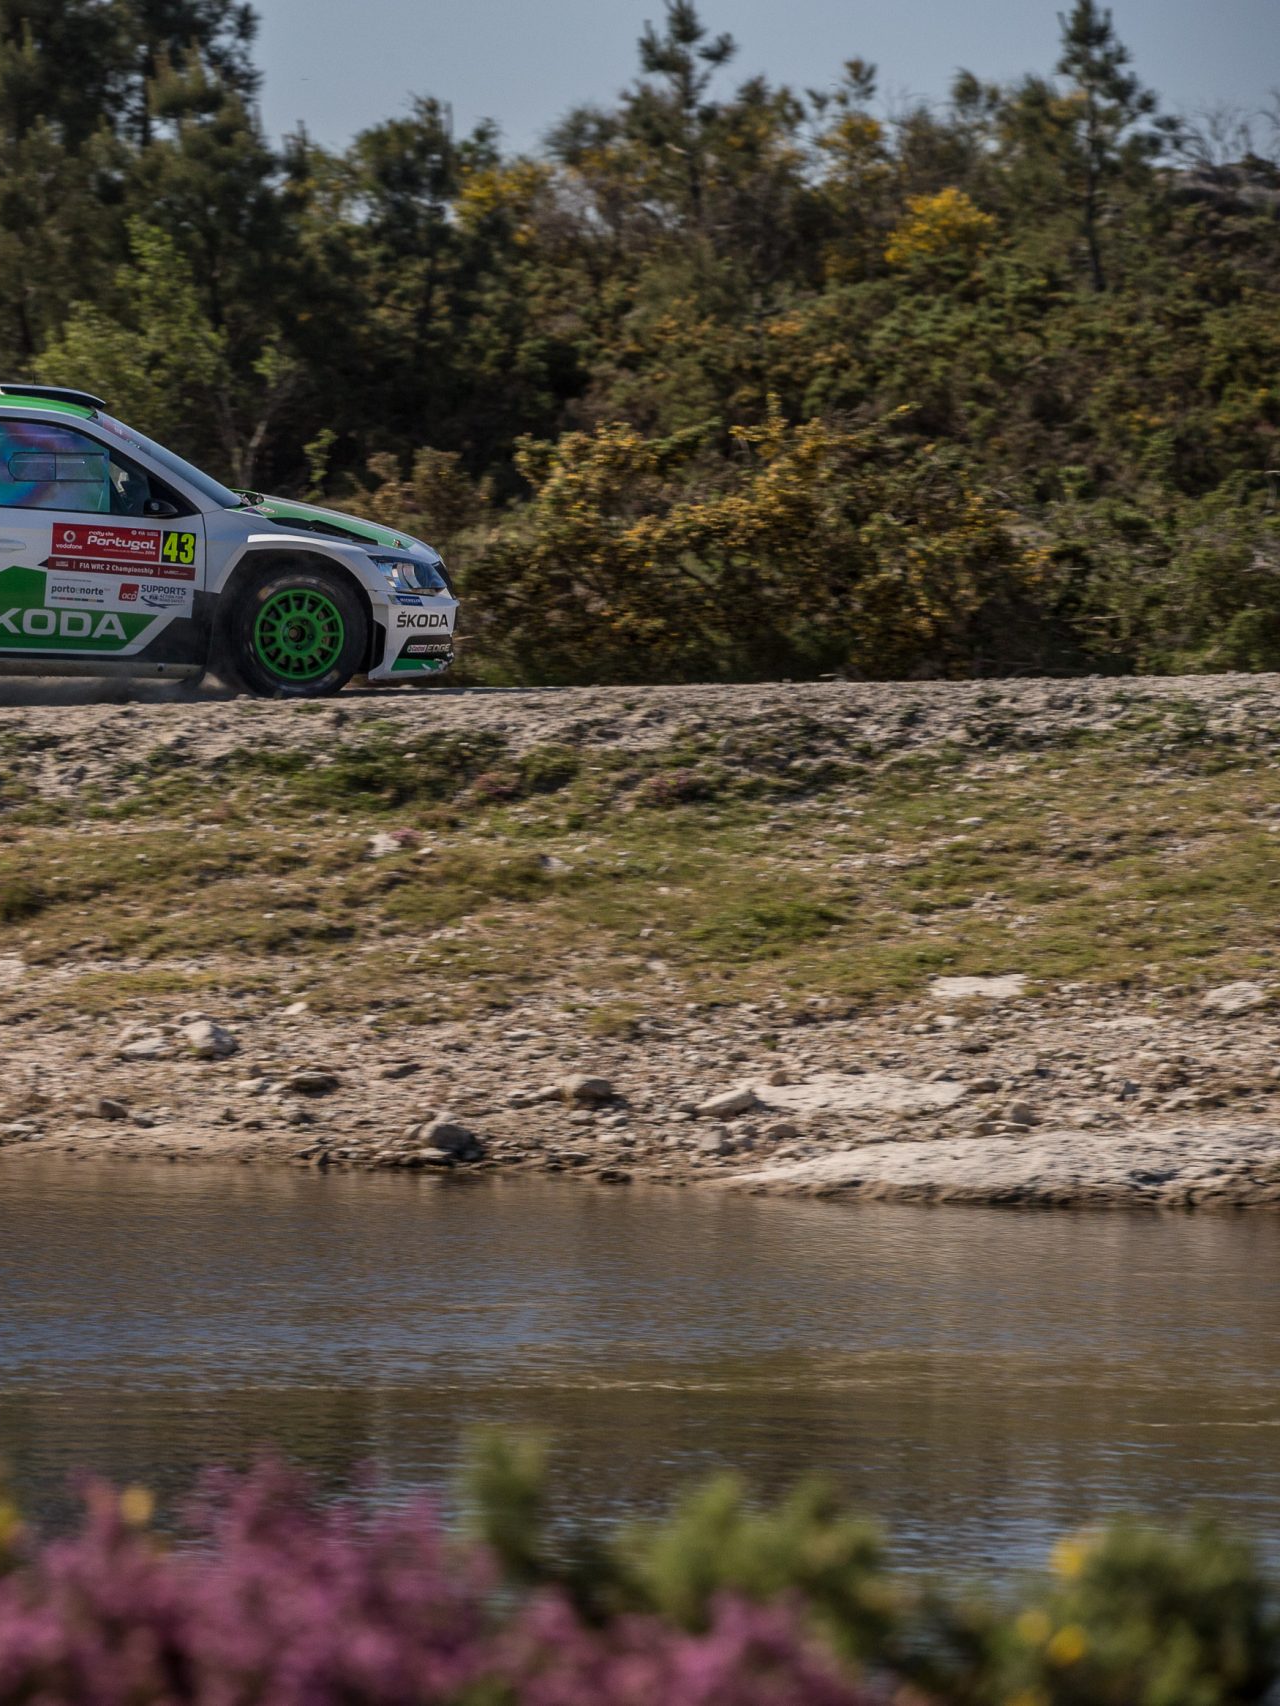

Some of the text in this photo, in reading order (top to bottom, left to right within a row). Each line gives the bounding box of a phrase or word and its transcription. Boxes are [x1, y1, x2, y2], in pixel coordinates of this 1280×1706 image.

[87, 535, 156, 551] Portugal
[163, 533, 195, 564] 43
[91, 563, 105, 571] WRC
[112, 565, 154, 575] Championship
[141, 584, 186, 596] SUPPORTS
[396, 611, 449, 628] ŠKODA
[425, 643, 451, 652] EDGE
